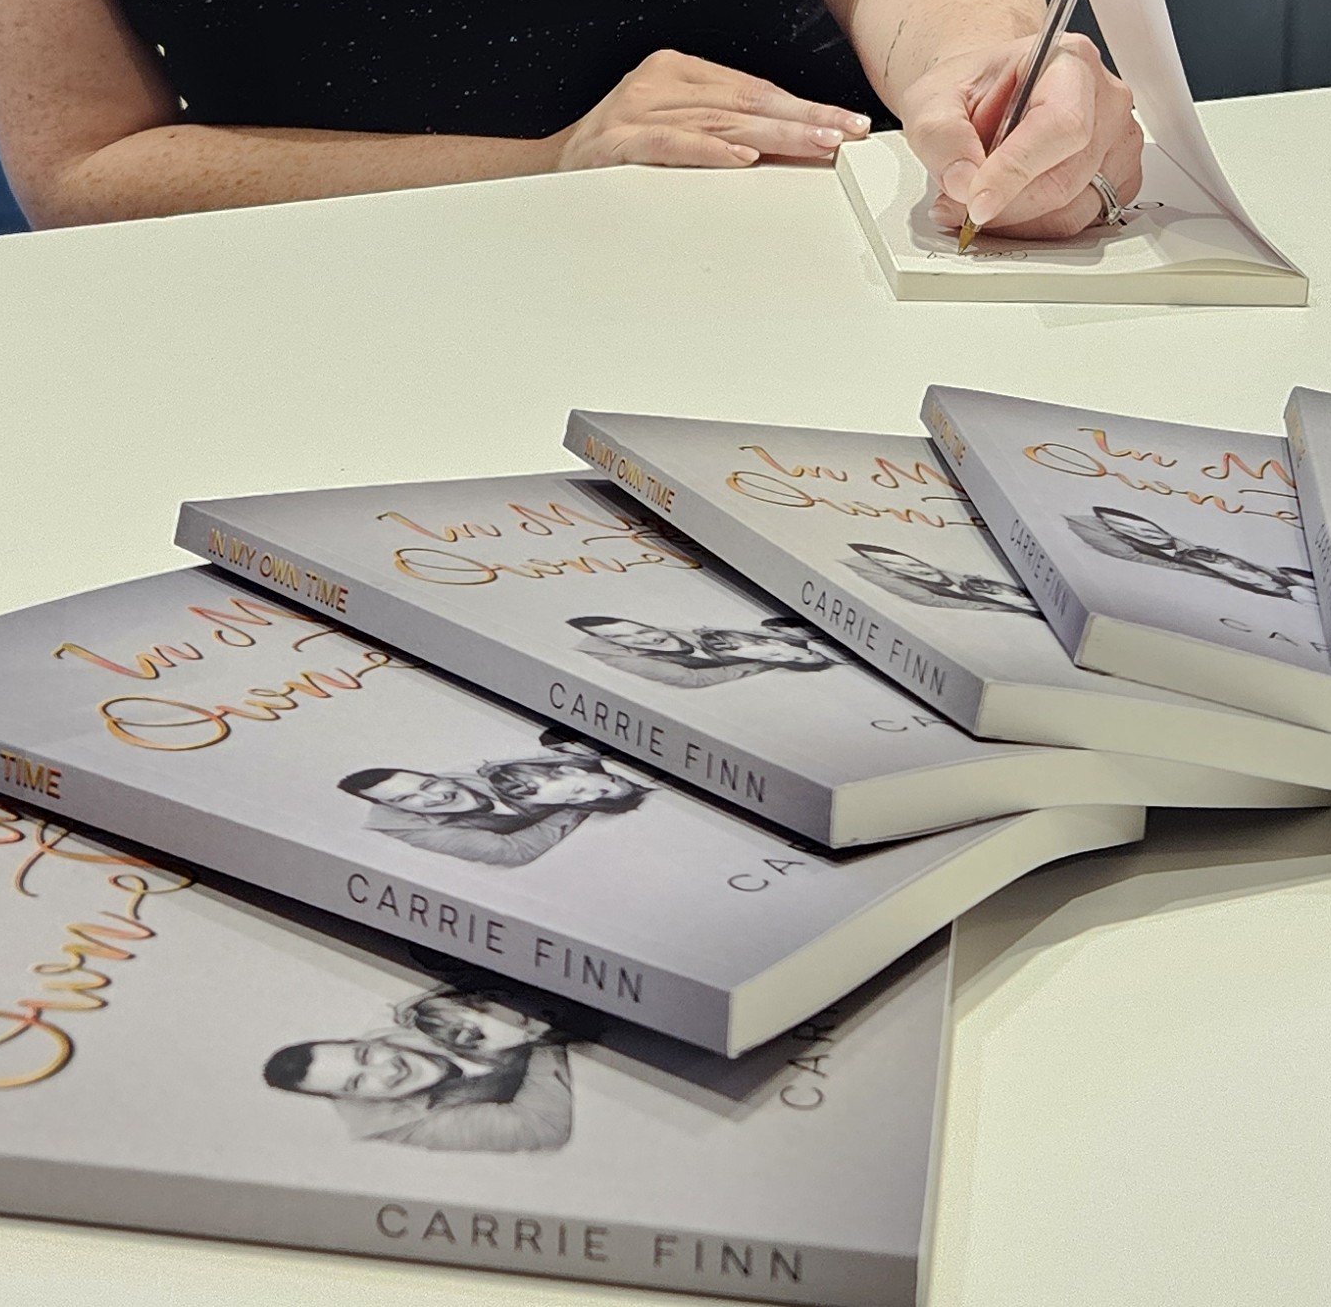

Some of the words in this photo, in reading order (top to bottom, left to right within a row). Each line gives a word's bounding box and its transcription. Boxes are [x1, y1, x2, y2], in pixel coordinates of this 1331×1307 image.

[645, 473, 676, 513] TIME
[725, 470, 945, 529] Own
[1022, 443, 1244, 514] Own
[208, 528, 227, 558] IN
[229, 537, 257, 570] MY
[259, 551, 302, 591] OWN
[305, 568, 349, 614] TIME
[394, 548, 628, 586] Own
[801, 580, 880, 652] CARRIE
[888, 638, 947, 696] FINN
[96, 666, 363, 752] Own
[549, 682, 664, 757] CARRIE
[684, 742, 767, 803] FINN
[0, 748, 62, 800] TIME
[347, 873, 507, 955] CARRIE
[535, 937, 644, 1004] FINN
[375, 1203, 611, 1264] CARRIE
[653, 1233, 804, 1283] FINN
